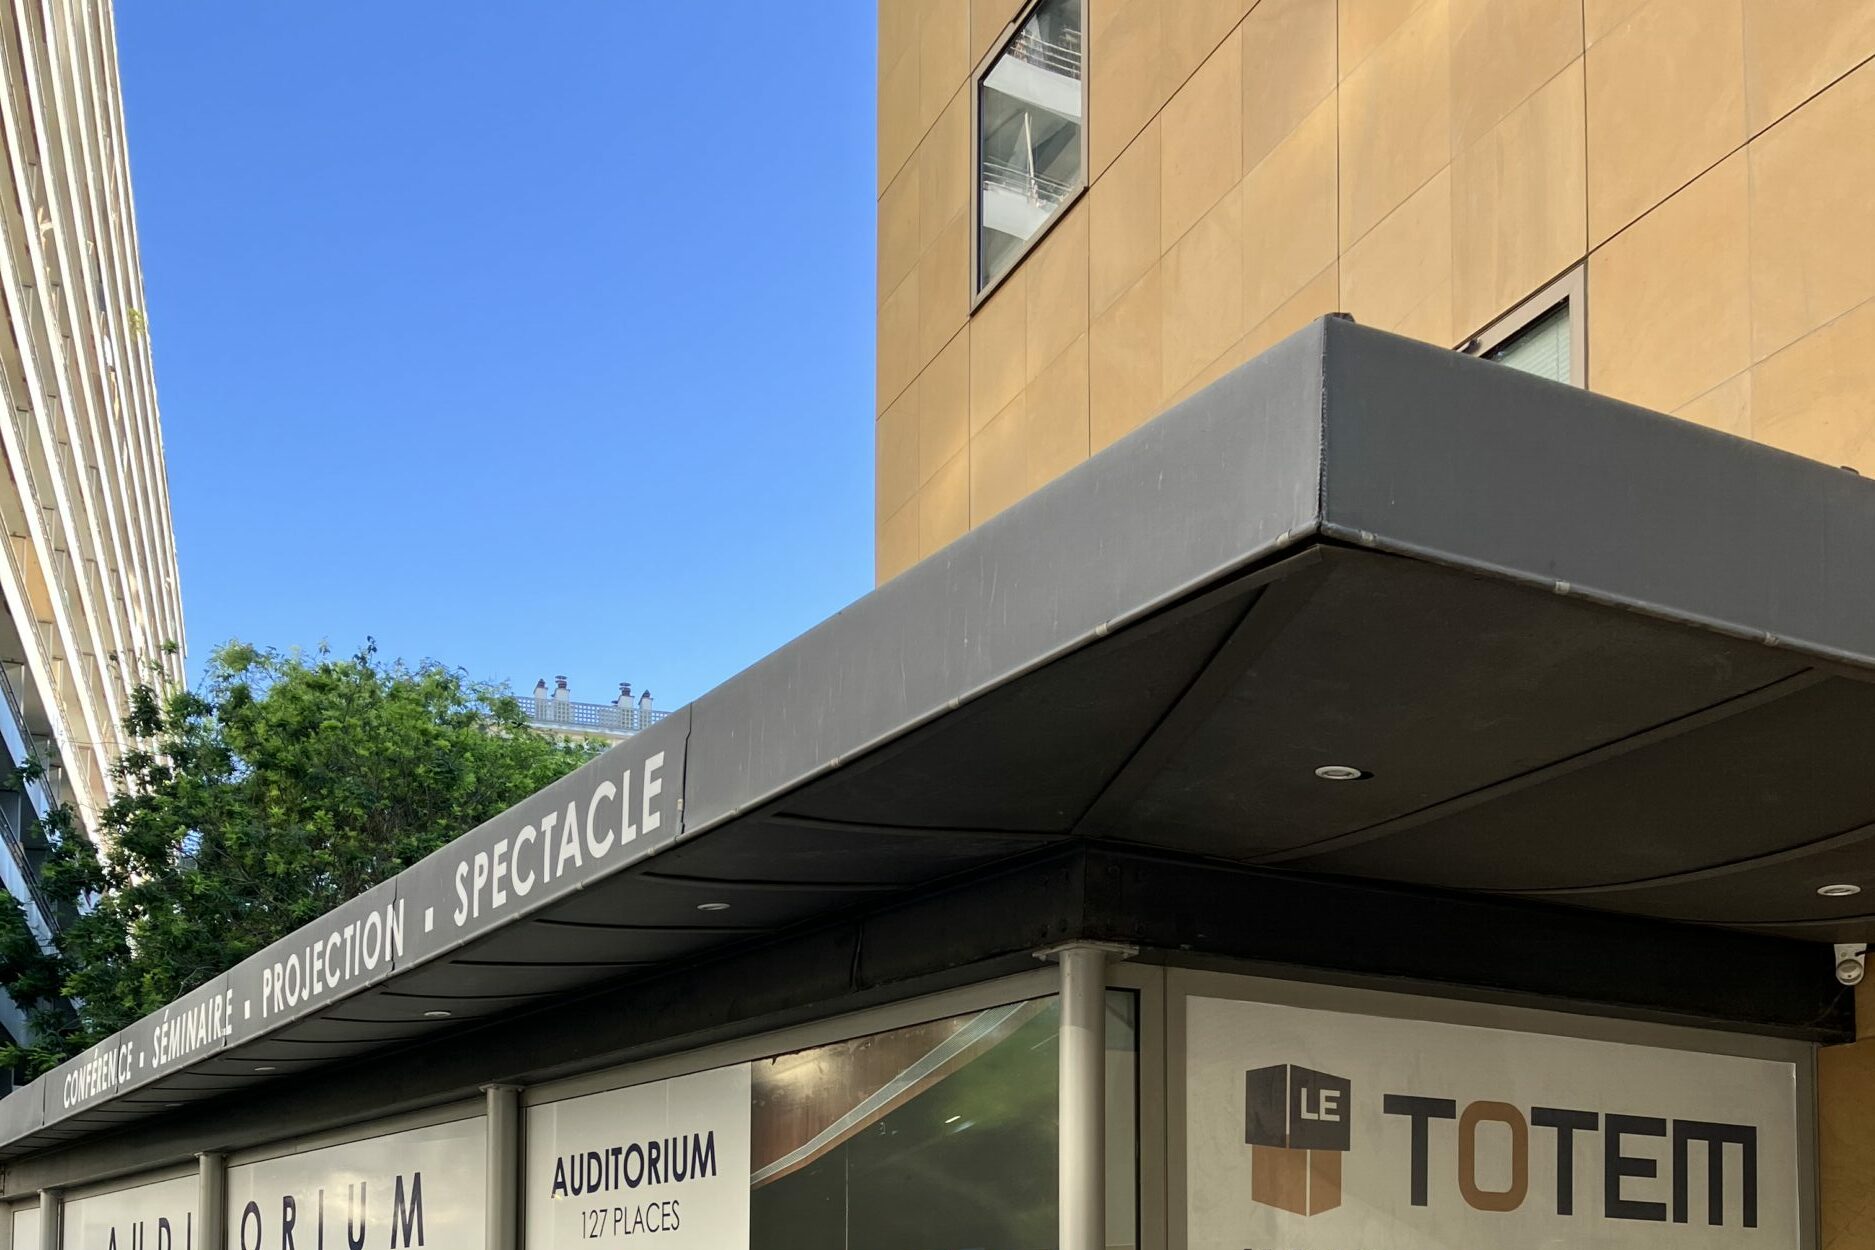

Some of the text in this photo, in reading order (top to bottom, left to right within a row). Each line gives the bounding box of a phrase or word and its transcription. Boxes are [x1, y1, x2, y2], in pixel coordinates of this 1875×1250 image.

[63, 750, 666, 1109] CONFÉRENCE SÉMINAIRE PROJECTION SPECTACLE
[1301, 1087, 1341, 1122] LE
[551, 1131, 717, 1199] AUDITORIUM
[1383, 1093, 1758, 1228] TOTEM
[581, 1200, 681, 1239] 127 PLACES
